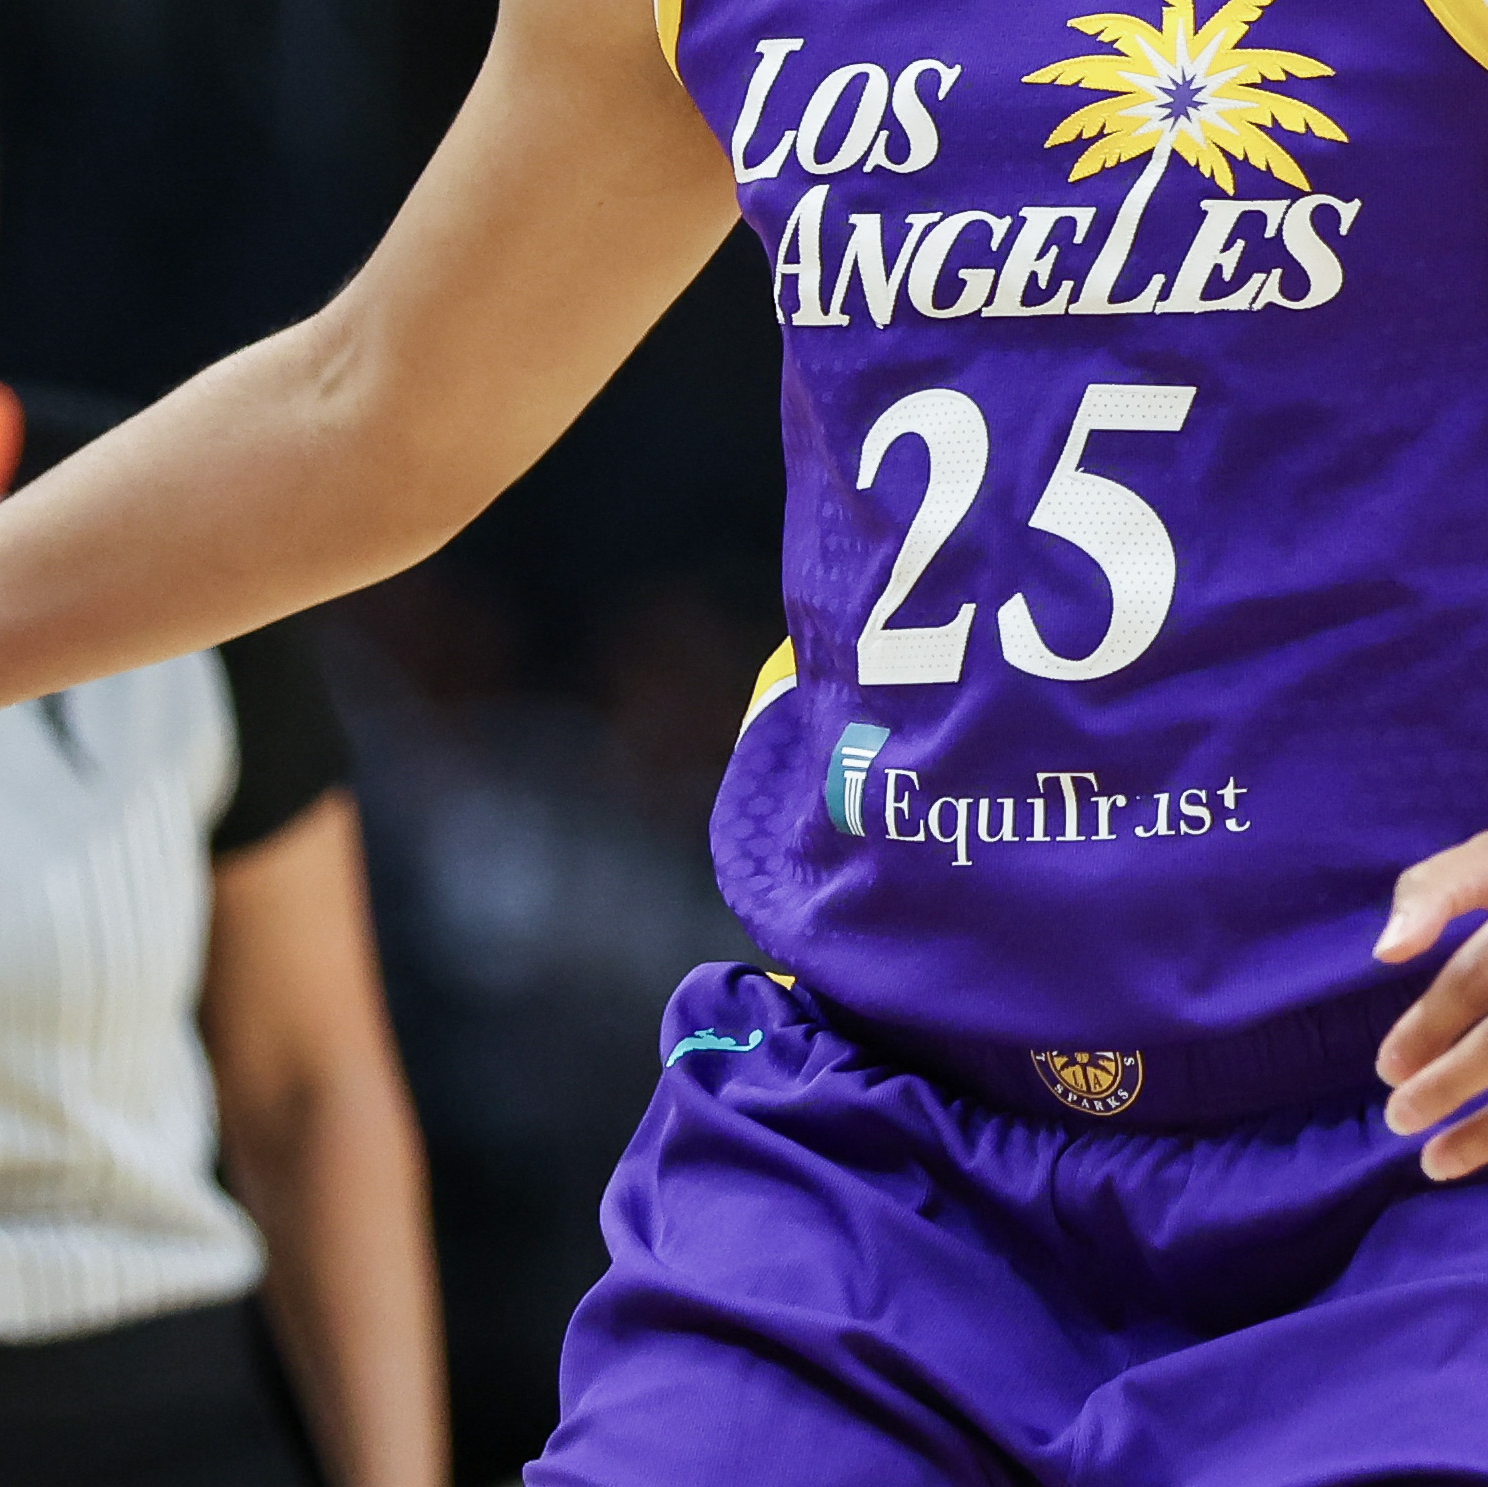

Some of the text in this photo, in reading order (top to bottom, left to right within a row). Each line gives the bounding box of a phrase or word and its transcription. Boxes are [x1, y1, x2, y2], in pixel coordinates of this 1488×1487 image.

[731, 38, 961, 184] LOS
[773, 184, 1362, 329] ANGELES
[856, 384, 1197, 685] 25
[1054, 1083, 1129, 1111] SPARKS
